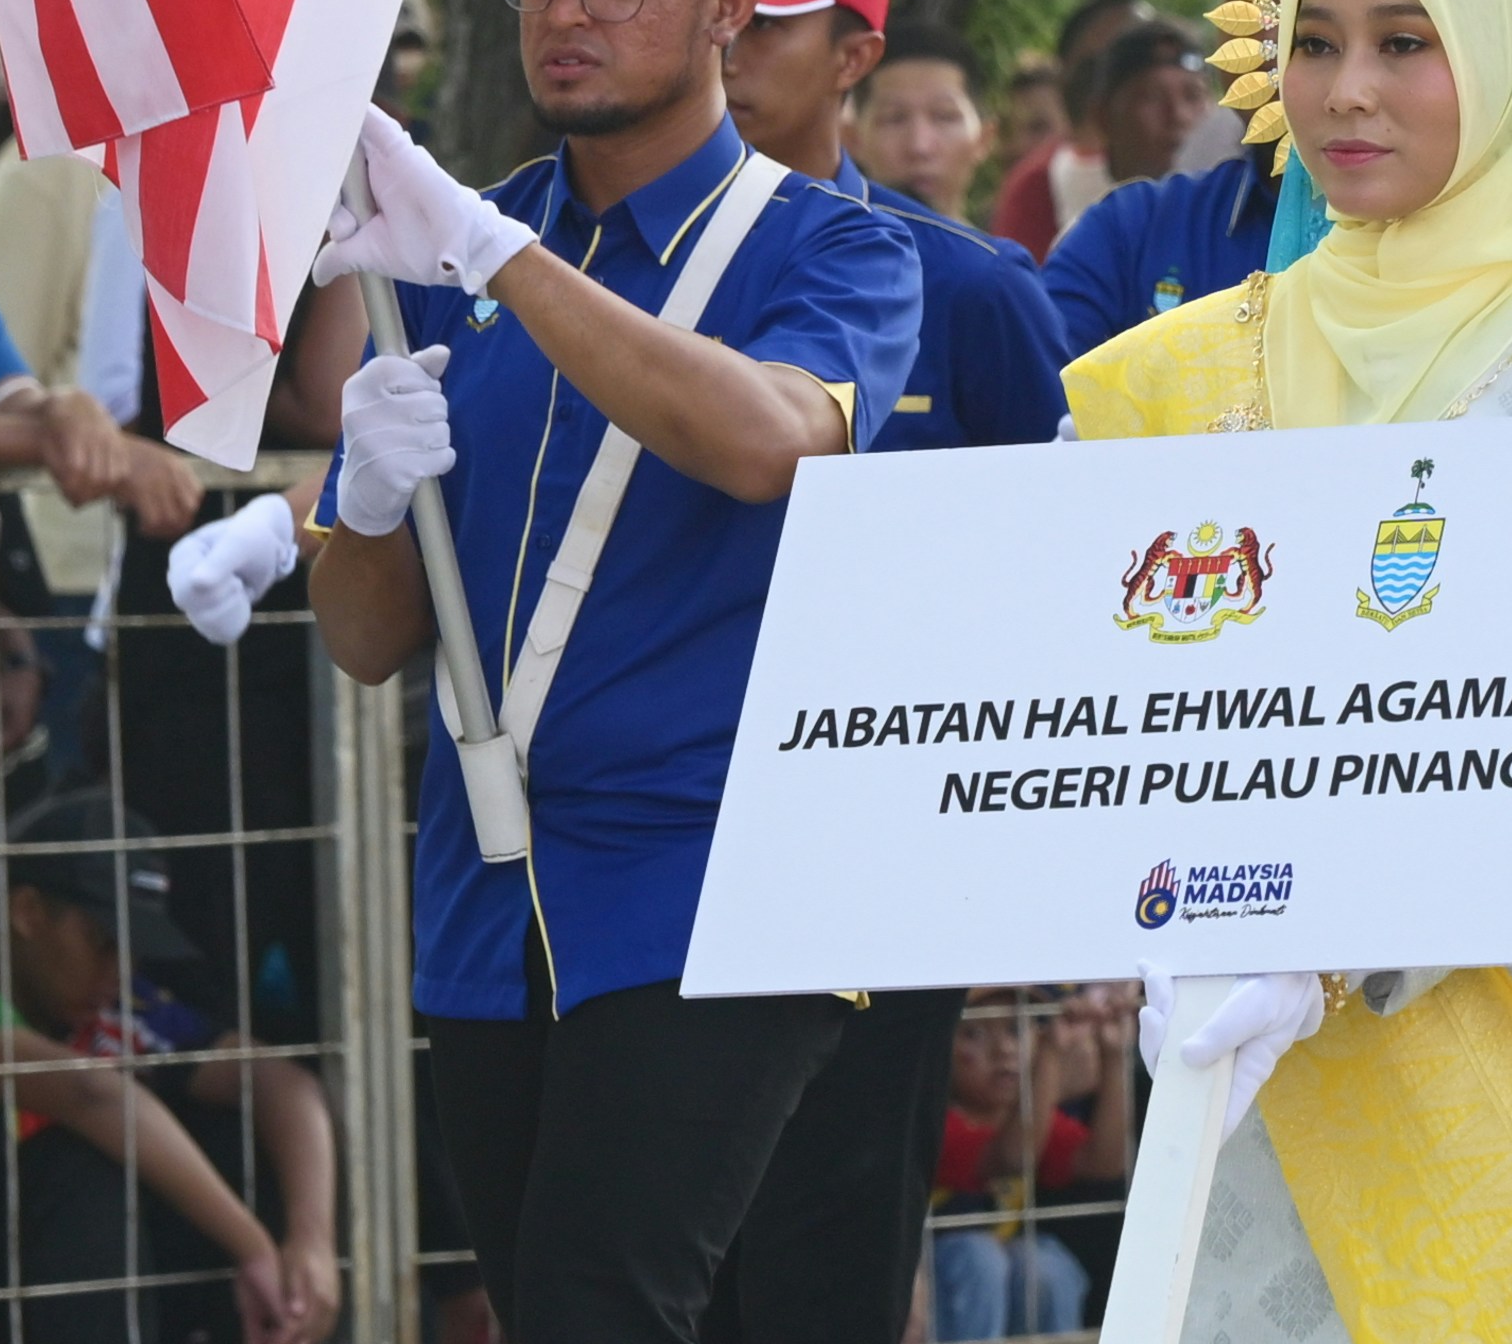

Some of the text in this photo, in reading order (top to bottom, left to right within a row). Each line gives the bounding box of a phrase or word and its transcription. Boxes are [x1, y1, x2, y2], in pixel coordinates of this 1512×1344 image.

[778, 696, 1015, 752] JABATAN
[1023, 695, 1129, 740] HAL
[1141, 685, 1326, 734] EHWAL
[939, 765, 1131, 814] NEGERI
[1139, 756, 1320, 806] PULAU
[1183, 880, 1293, 905] MADANI
[1187, 862, 1294, 883] MALAYSIA
